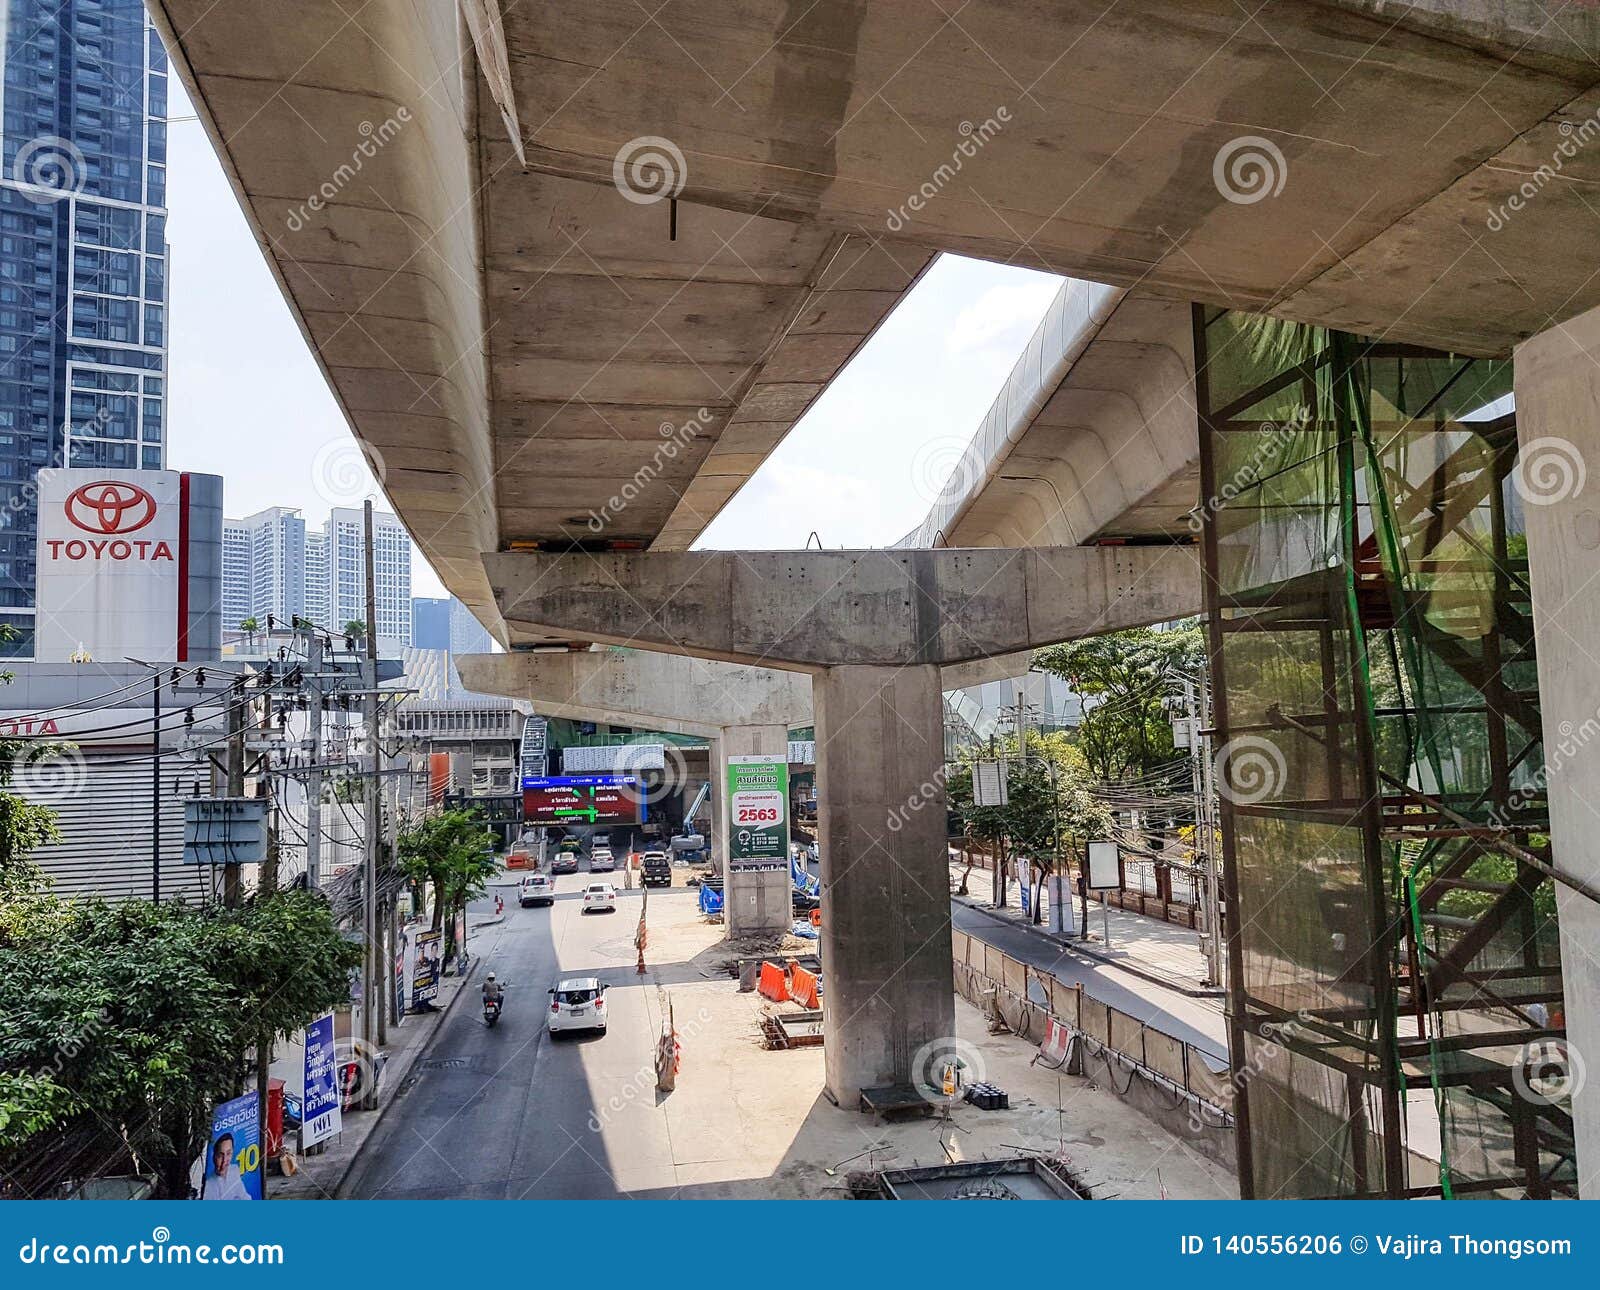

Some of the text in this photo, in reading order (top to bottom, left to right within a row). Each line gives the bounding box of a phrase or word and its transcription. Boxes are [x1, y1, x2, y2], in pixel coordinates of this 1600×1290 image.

[47, 540, 174, 561] TOYOTA
[738, 808, 777, 822] 2563
[236, 1143, 260, 1175] 10
